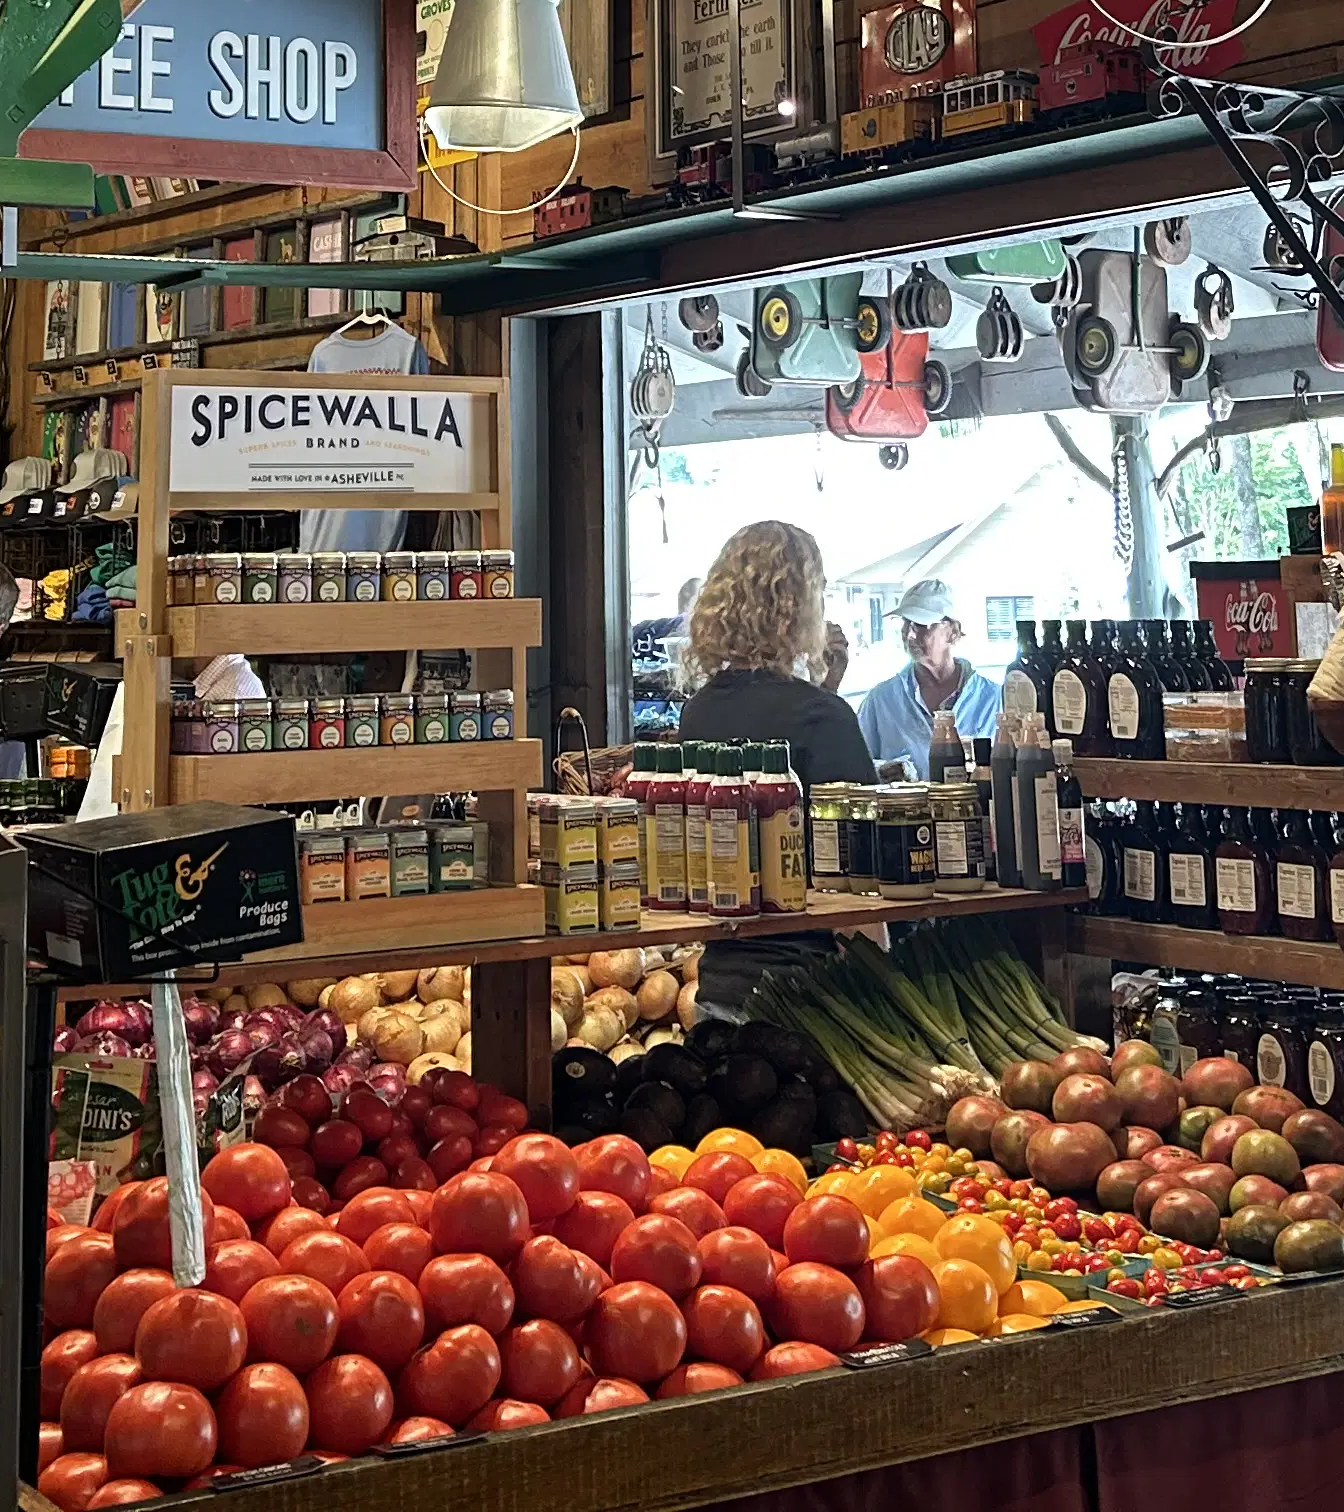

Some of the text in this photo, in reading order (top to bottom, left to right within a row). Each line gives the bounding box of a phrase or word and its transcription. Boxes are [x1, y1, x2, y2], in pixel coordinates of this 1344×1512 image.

[420, 0, 451, 20] GROVES
[681, 38, 702, 56] They
[886, 7, 949, 70] CLAY
[683, 58, 698, 73] and
[209, 29, 357, 124] SHOP
[191, 394, 464, 448] SPICEWALLA
[306, 438, 360, 448] BRAND
[274, 474, 292, 482] WITH
[294, 474, 312, 482] LOVE
[331, 470, 394, 485] ASHEVILLE
[111, 861, 169, 909] Tug
[239, 900, 288, 918] Produce
[259, 911, 288, 926] Bags
[84, 1108, 132, 1131] DINI'S
